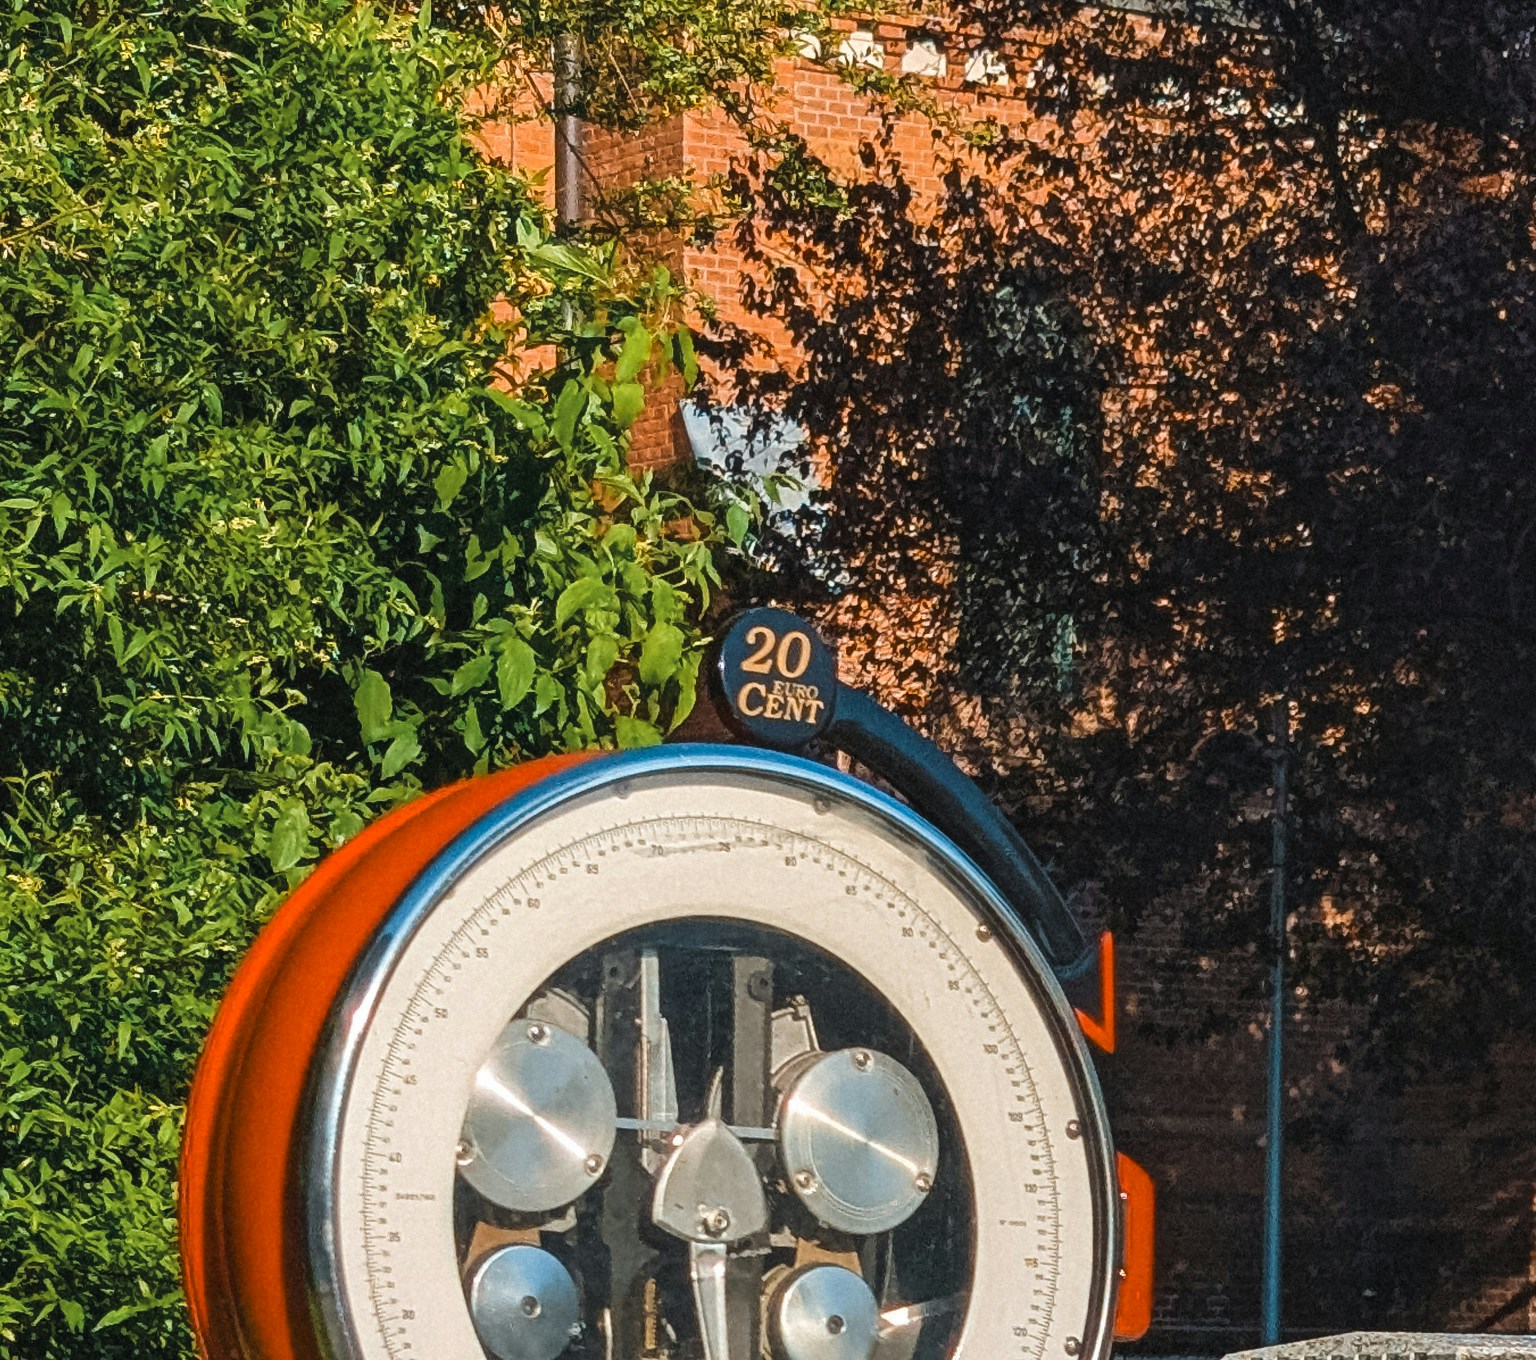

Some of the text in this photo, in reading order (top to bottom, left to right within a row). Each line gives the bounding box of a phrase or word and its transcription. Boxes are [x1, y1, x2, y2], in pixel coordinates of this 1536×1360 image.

[740, 626, 811, 679] 20
[737, 682, 824, 724] CENT
[773, 680, 819, 699] EURO
[651, 844, 664, 855] 70
